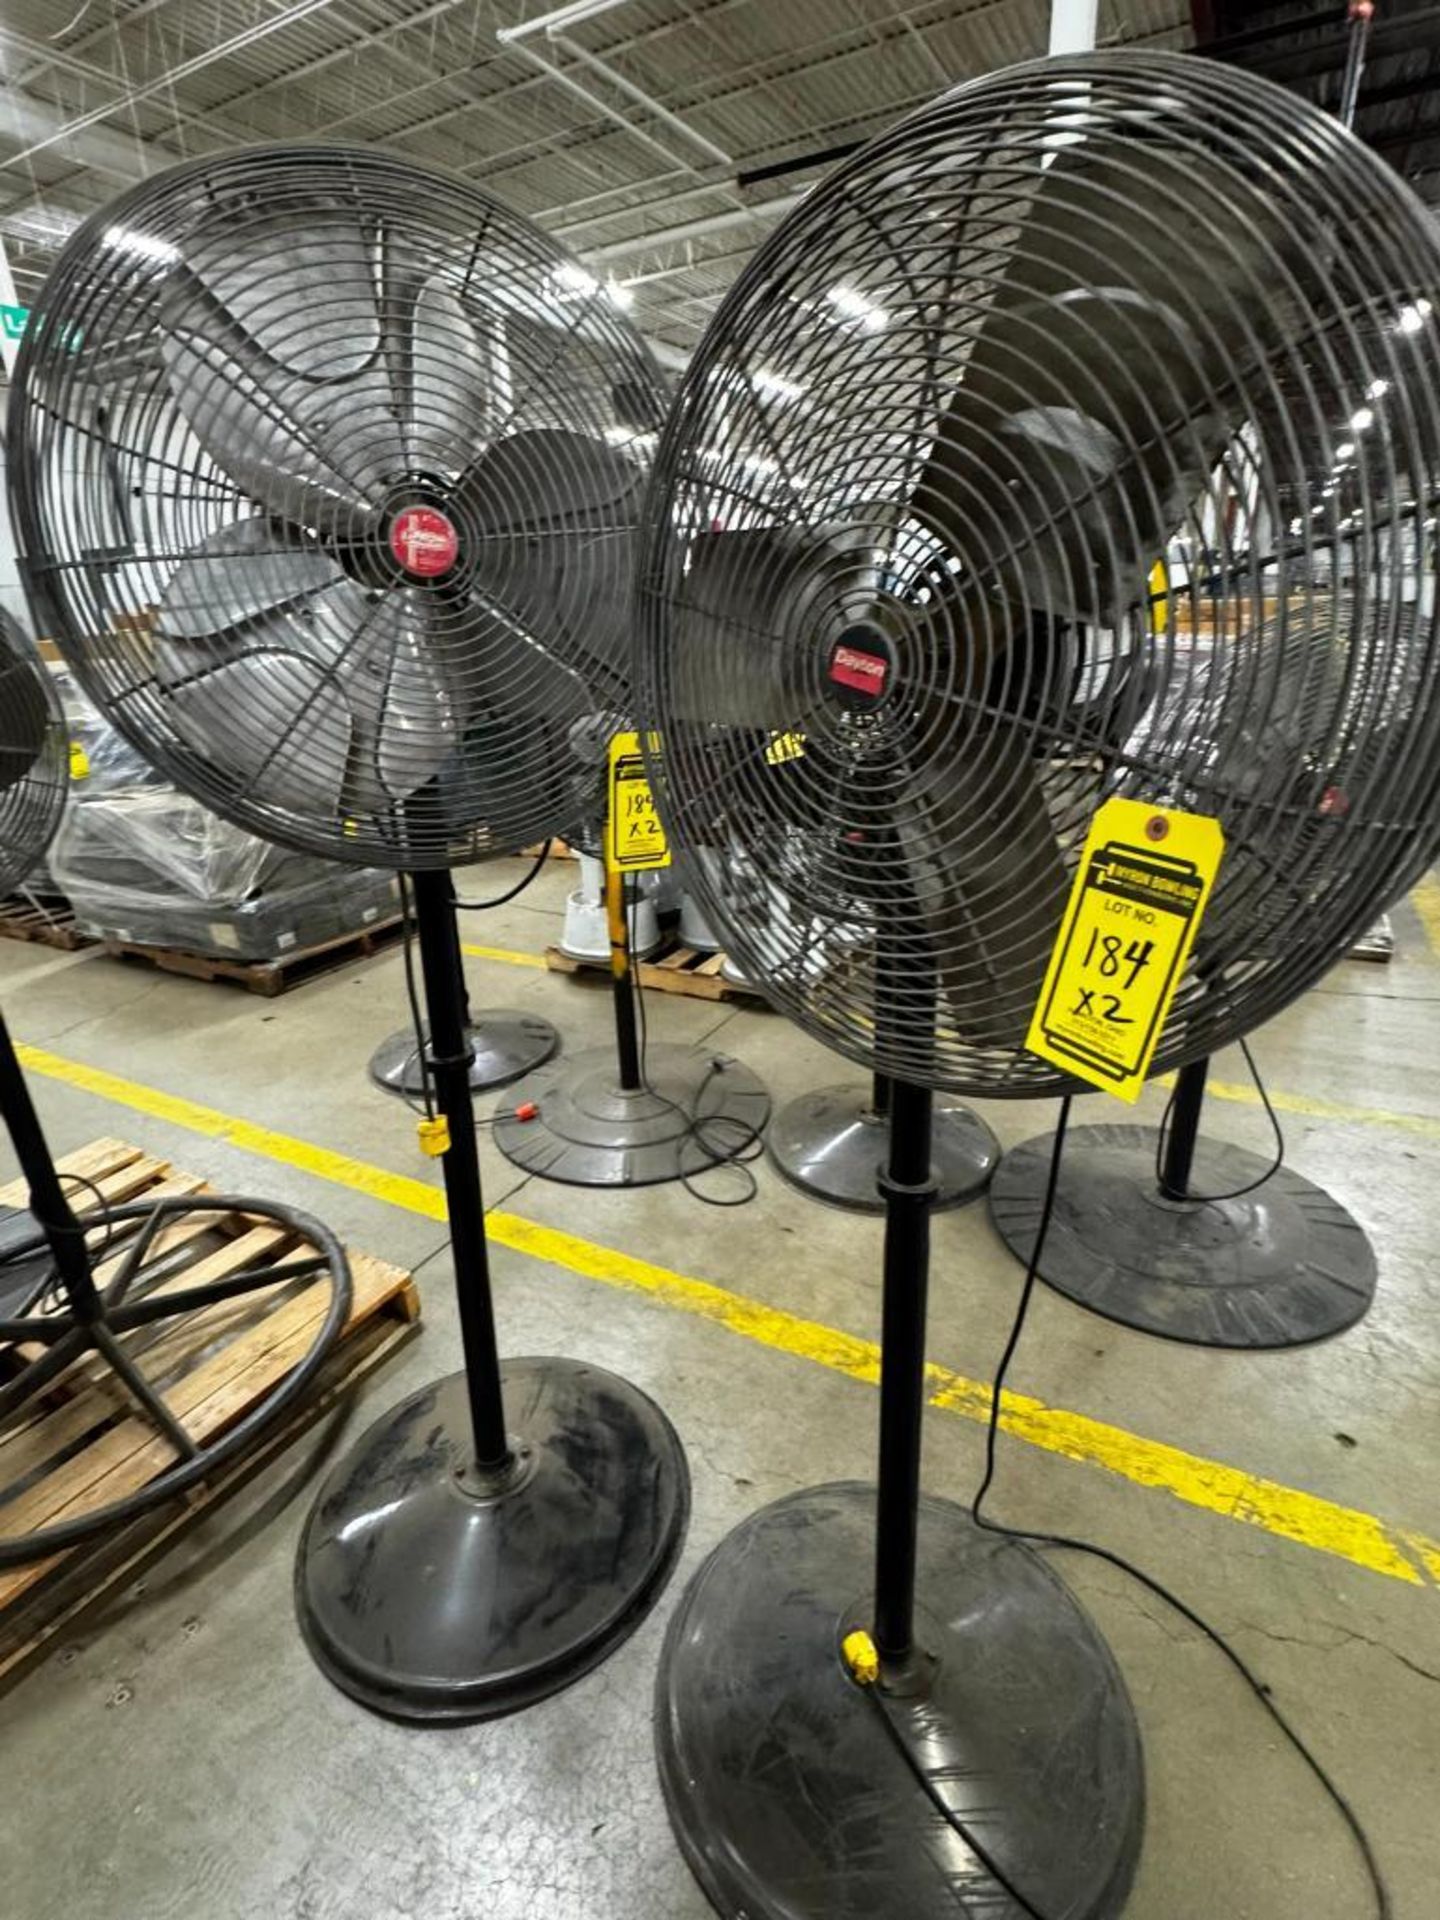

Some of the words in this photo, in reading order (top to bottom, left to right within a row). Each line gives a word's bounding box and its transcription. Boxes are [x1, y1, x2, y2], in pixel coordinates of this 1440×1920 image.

[835, 649, 885, 678] Dayton
[1104, 898, 1132, 917] LOT
[1134, 908, 1157, 927] NO.
[1082, 926, 1155, 990] 184
